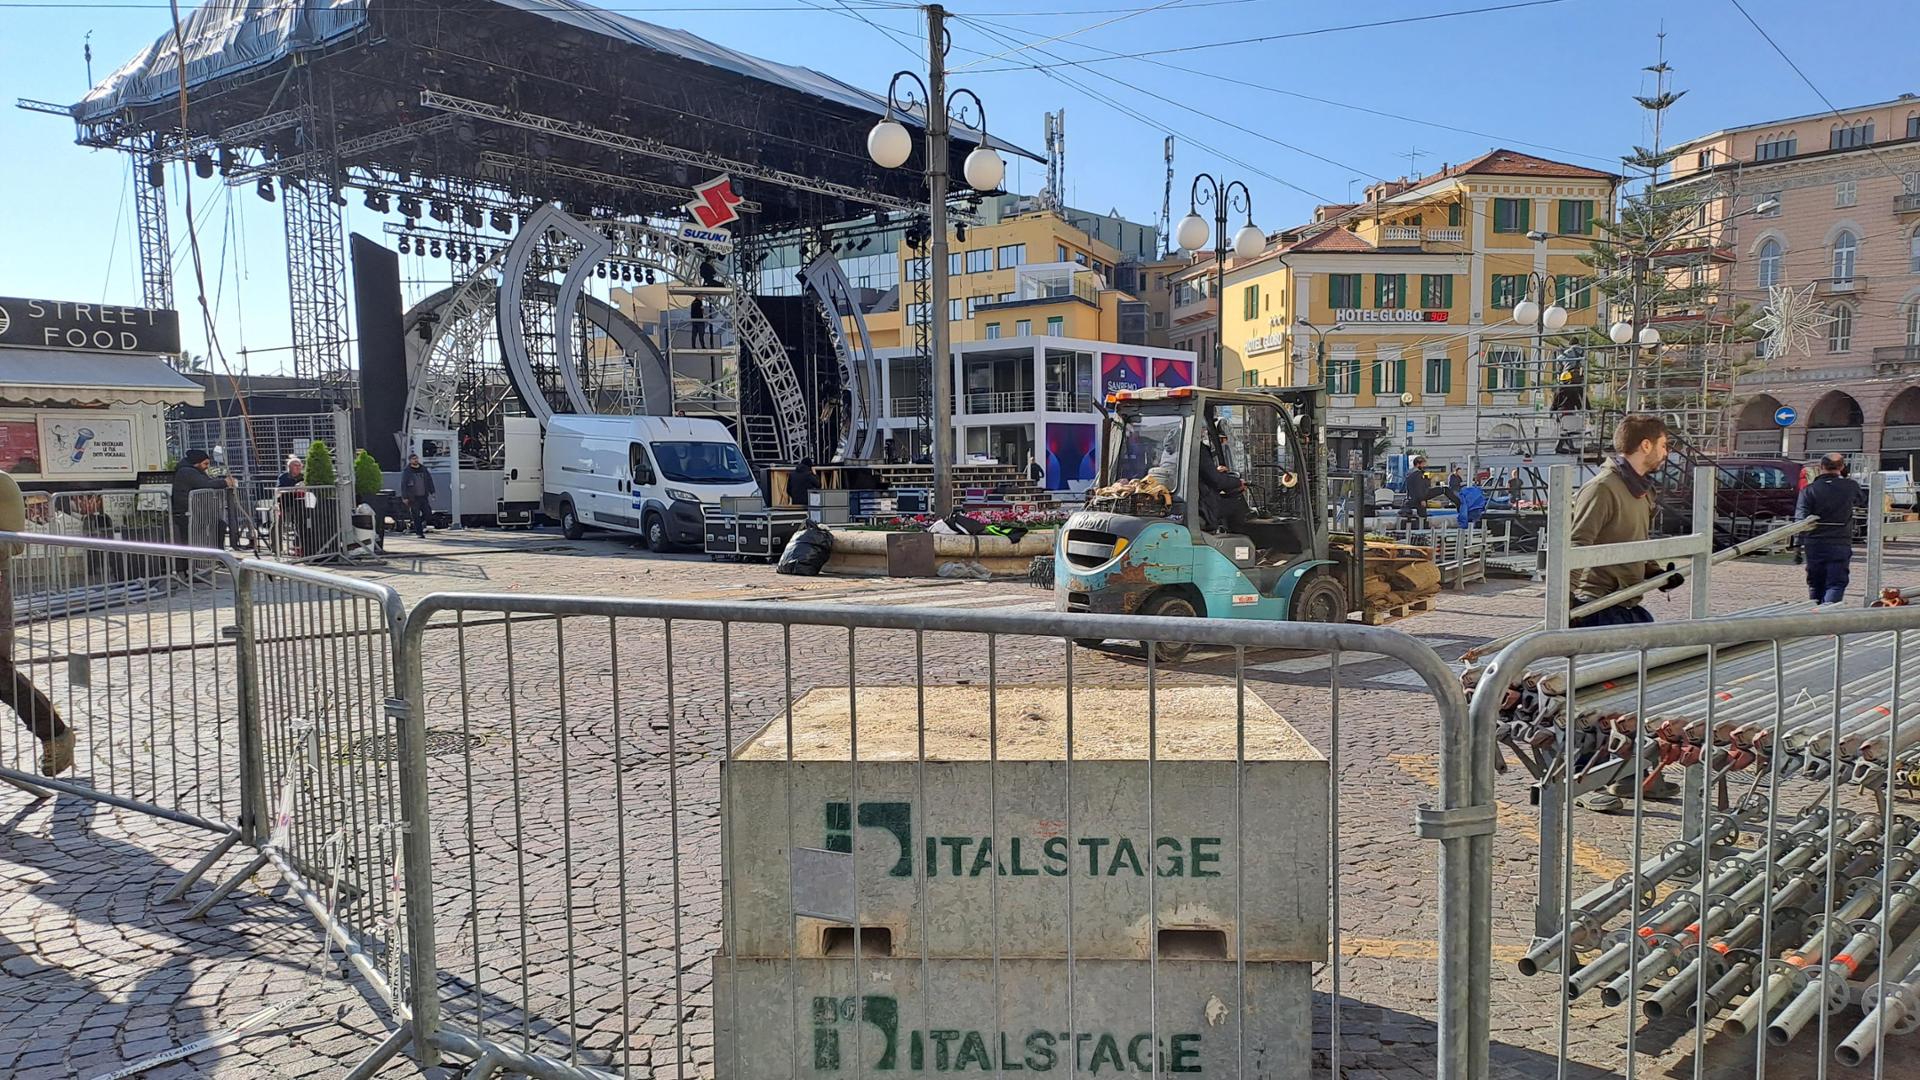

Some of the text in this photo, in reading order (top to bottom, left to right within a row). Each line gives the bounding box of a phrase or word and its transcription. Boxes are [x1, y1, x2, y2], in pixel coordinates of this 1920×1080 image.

[683, 228, 727, 241] SUZUKI
[710, 243, 732, 254] stage
[28, 299, 158, 326] STREET
[1336, 308, 1422, 322] HOTEL GLOBO
[44, 328, 138, 350] FOOD
[1107, 380, 1137, 391] SANREMO
[927, 836, 1222, 878] ITALSTAGE
[910, 1030, 1203, 1074] ITALSTAGE
